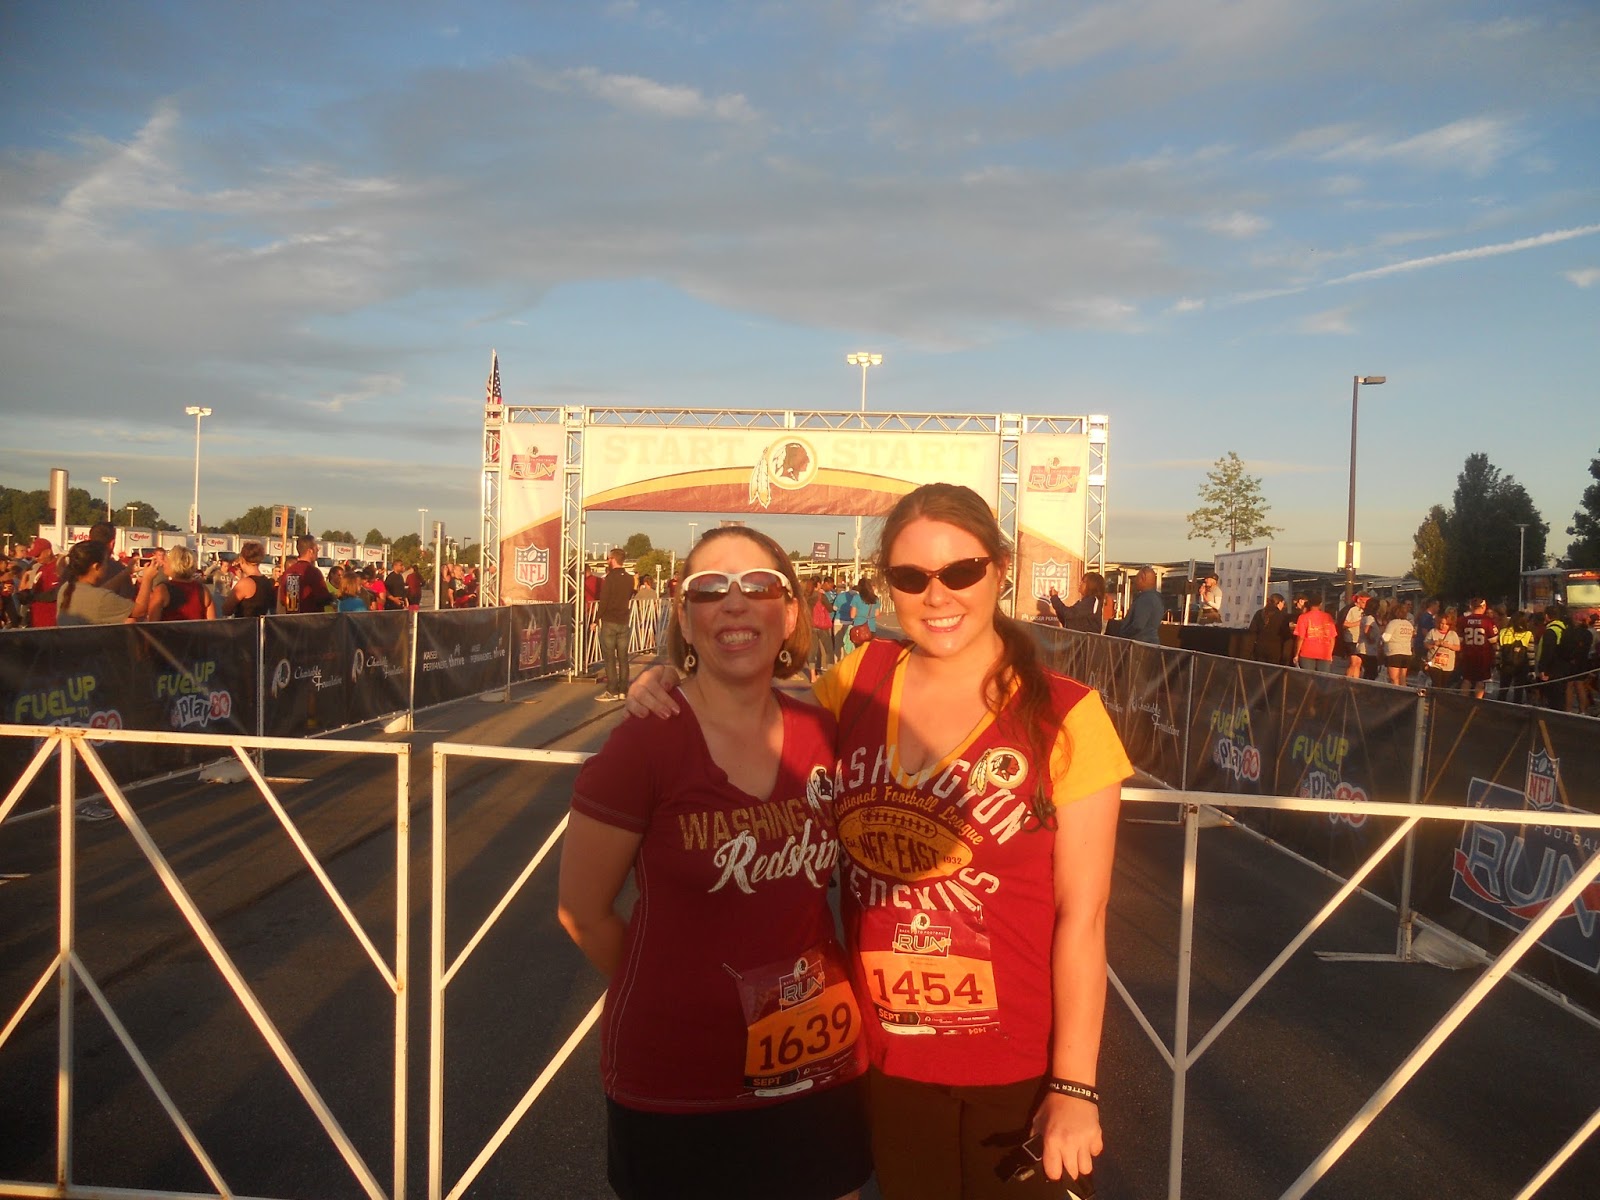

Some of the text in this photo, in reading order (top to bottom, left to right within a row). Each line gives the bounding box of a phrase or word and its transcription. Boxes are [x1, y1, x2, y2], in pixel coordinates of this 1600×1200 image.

[604, 434, 745, 465] START
[832, 437, 978, 469] START
[513, 462, 553, 477] RUN
[1032, 473, 1075, 488] RUN
[73, 530, 91, 541] yde
[134, 532, 150, 540] Ryder
[519, 563, 544, 583] NFL
[1036, 578, 1065, 596] NFL
[1464, 627, 1485, 646] 26
[194, 661, 216, 683] UP
[15, 675, 97, 723] FUEL UP
[78, 706, 89, 718] TO
[1210, 707, 1250, 739] FUEL UP
[1292, 734, 1349, 771] FUEL UP
[1328, 768, 1338, 783] TO
[1529, 773, 1552, 804] NFL
[884, 786, 939, 813] Football
[938, 805, 984, 845] League
[859, 831, 940, 874] NFC EAST
[943, 856, 962, 865] 1932
[1468, 822, 1597, 938] RUN
[898, 933, 946, 953] RUN
[784, 976, 823, 1002] RUN
[872, 968, 984, 1006] 1454
[878, 1007, 901, 1022] SEPT
[759, 1001, 852, 1071] 1639
[753, 1076, 782, 1087] SEPT
[1062, 1084, 1092, 1097] BETTER
